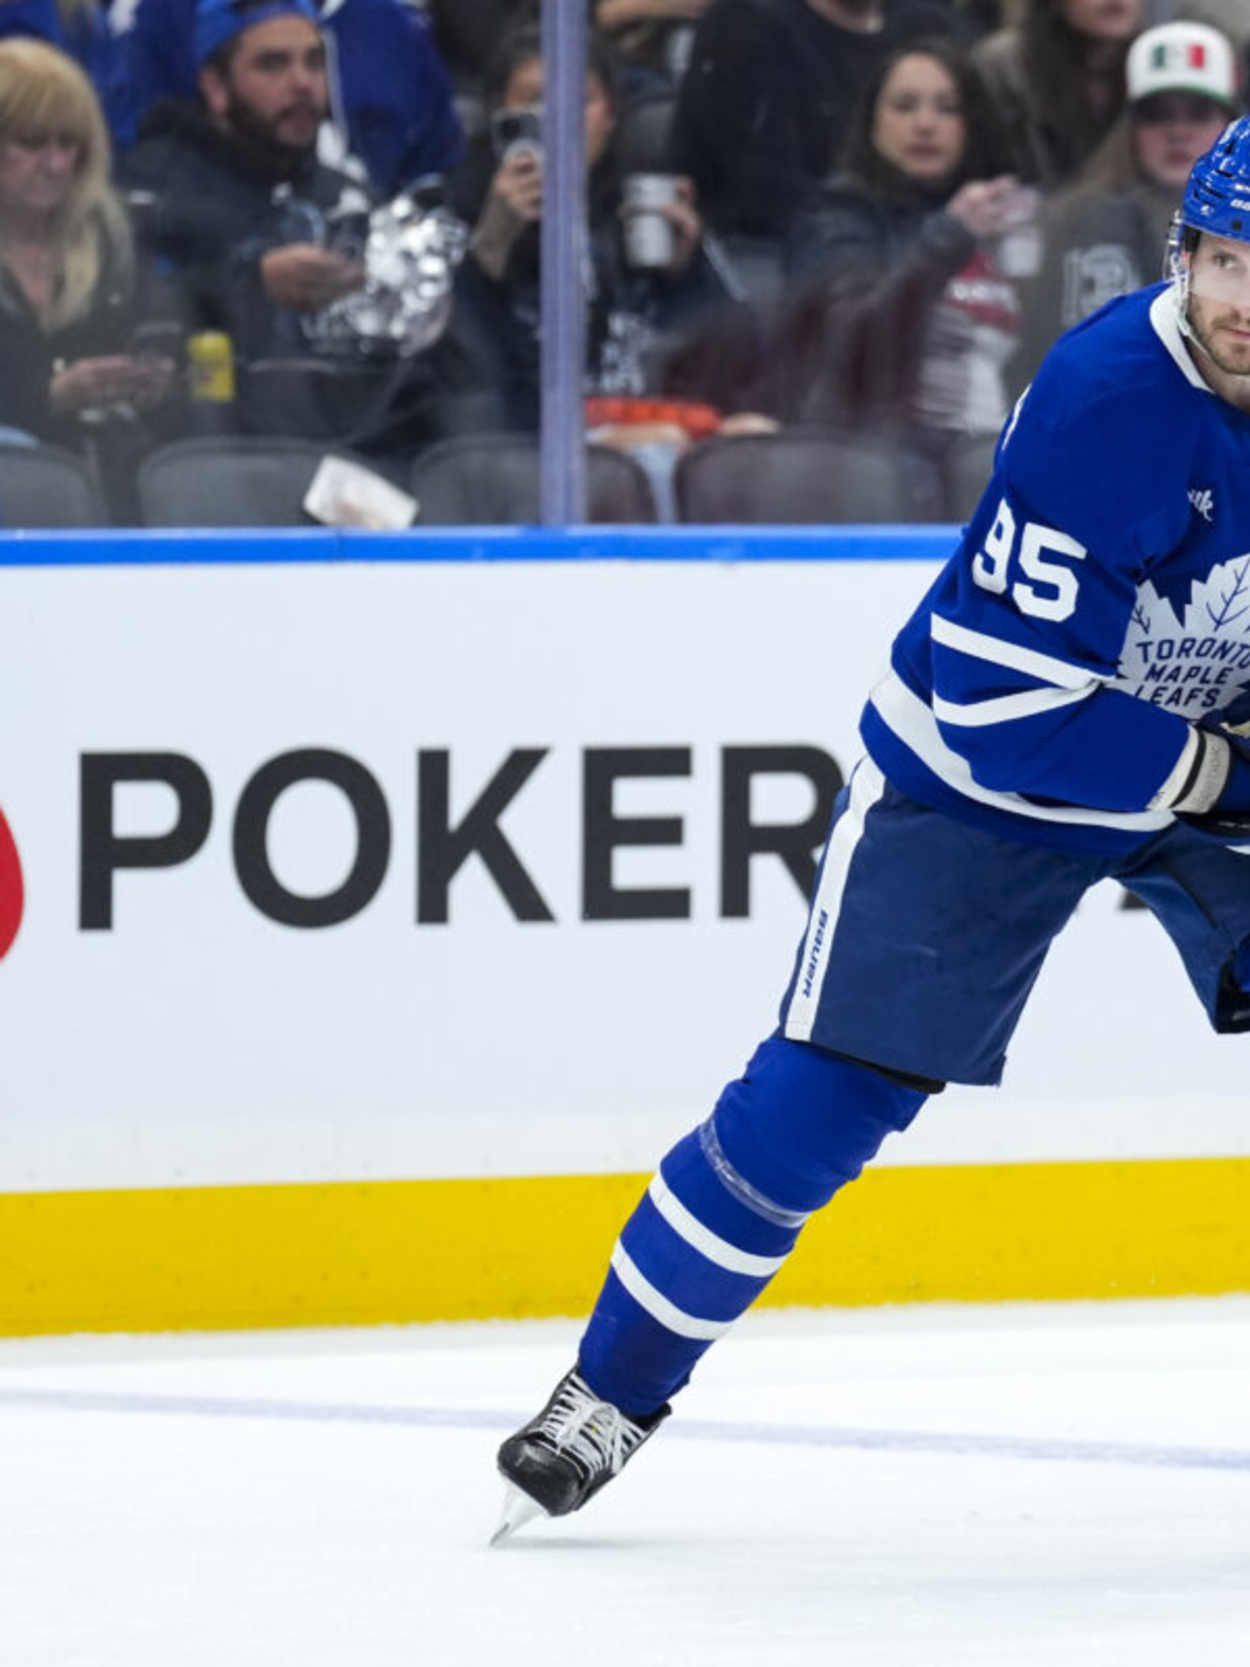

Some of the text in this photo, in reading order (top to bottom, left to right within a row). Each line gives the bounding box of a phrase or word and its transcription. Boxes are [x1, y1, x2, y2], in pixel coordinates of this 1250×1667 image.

[971, 497, 1089, 622] 95
[1144, 663, 1234, 685] MAPLE
[1134, 684, 1222, 708] LEAFS
